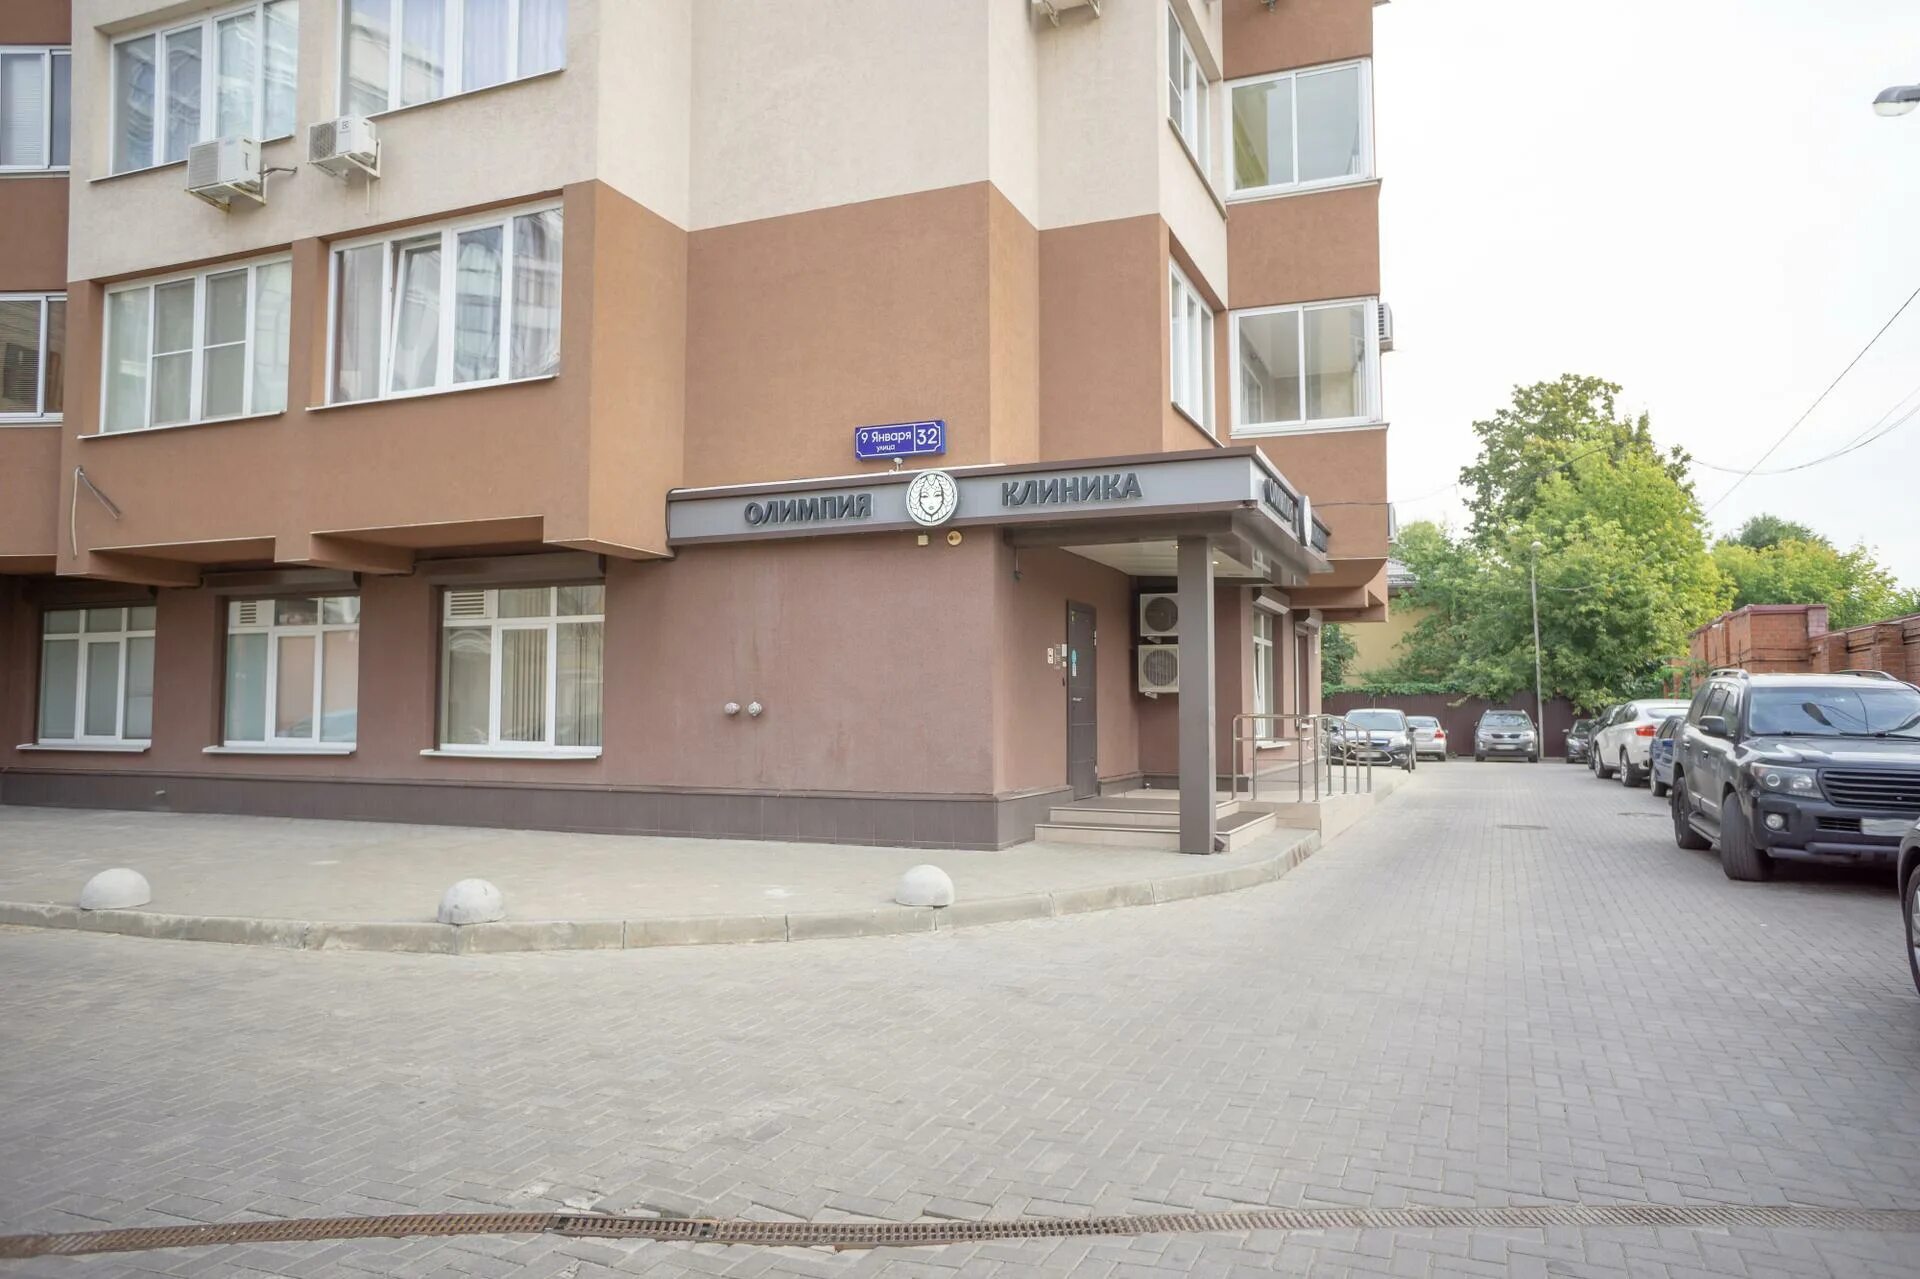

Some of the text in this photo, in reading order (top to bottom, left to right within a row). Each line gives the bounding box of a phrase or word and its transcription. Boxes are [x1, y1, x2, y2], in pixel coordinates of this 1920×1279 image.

[861, 431, 911, 443] 9 Января
[917, 428, 938, 445] 32
[876, 444, 895, 452] улица
[744, 473, 1143, 525] ОЛИМПИЯ КЛИНИКА
